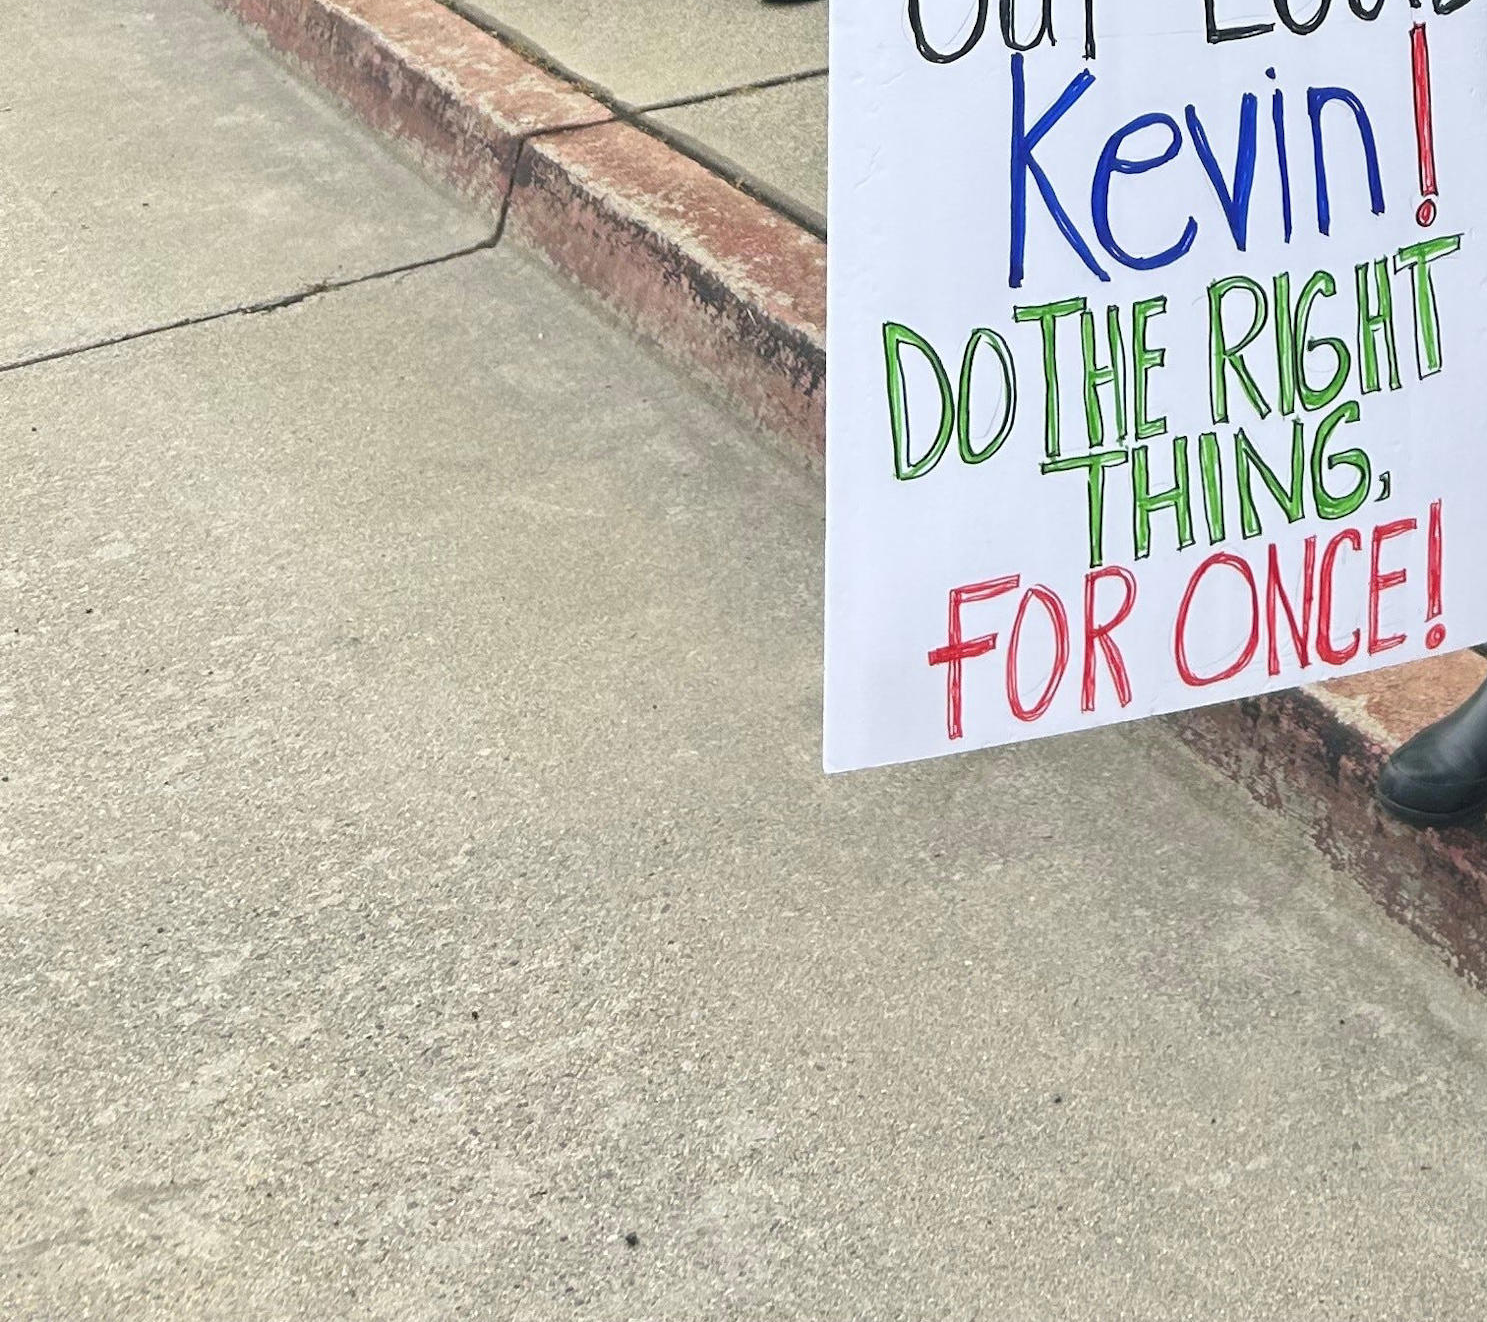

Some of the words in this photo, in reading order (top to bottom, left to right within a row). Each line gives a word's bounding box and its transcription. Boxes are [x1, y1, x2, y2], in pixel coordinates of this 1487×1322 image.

[1008, 21, 1440, 289] Kevin!
[883, 321, 1018, 481] DO
[1013, 296, 1169, 457] THE
[1206, 234, 1462, 424] RIGHT
[1040, 399, 1391, 567] THING,
[928, 565, 1138, 740] FOR
[1176, 498, 1446, 688] ONCE!
